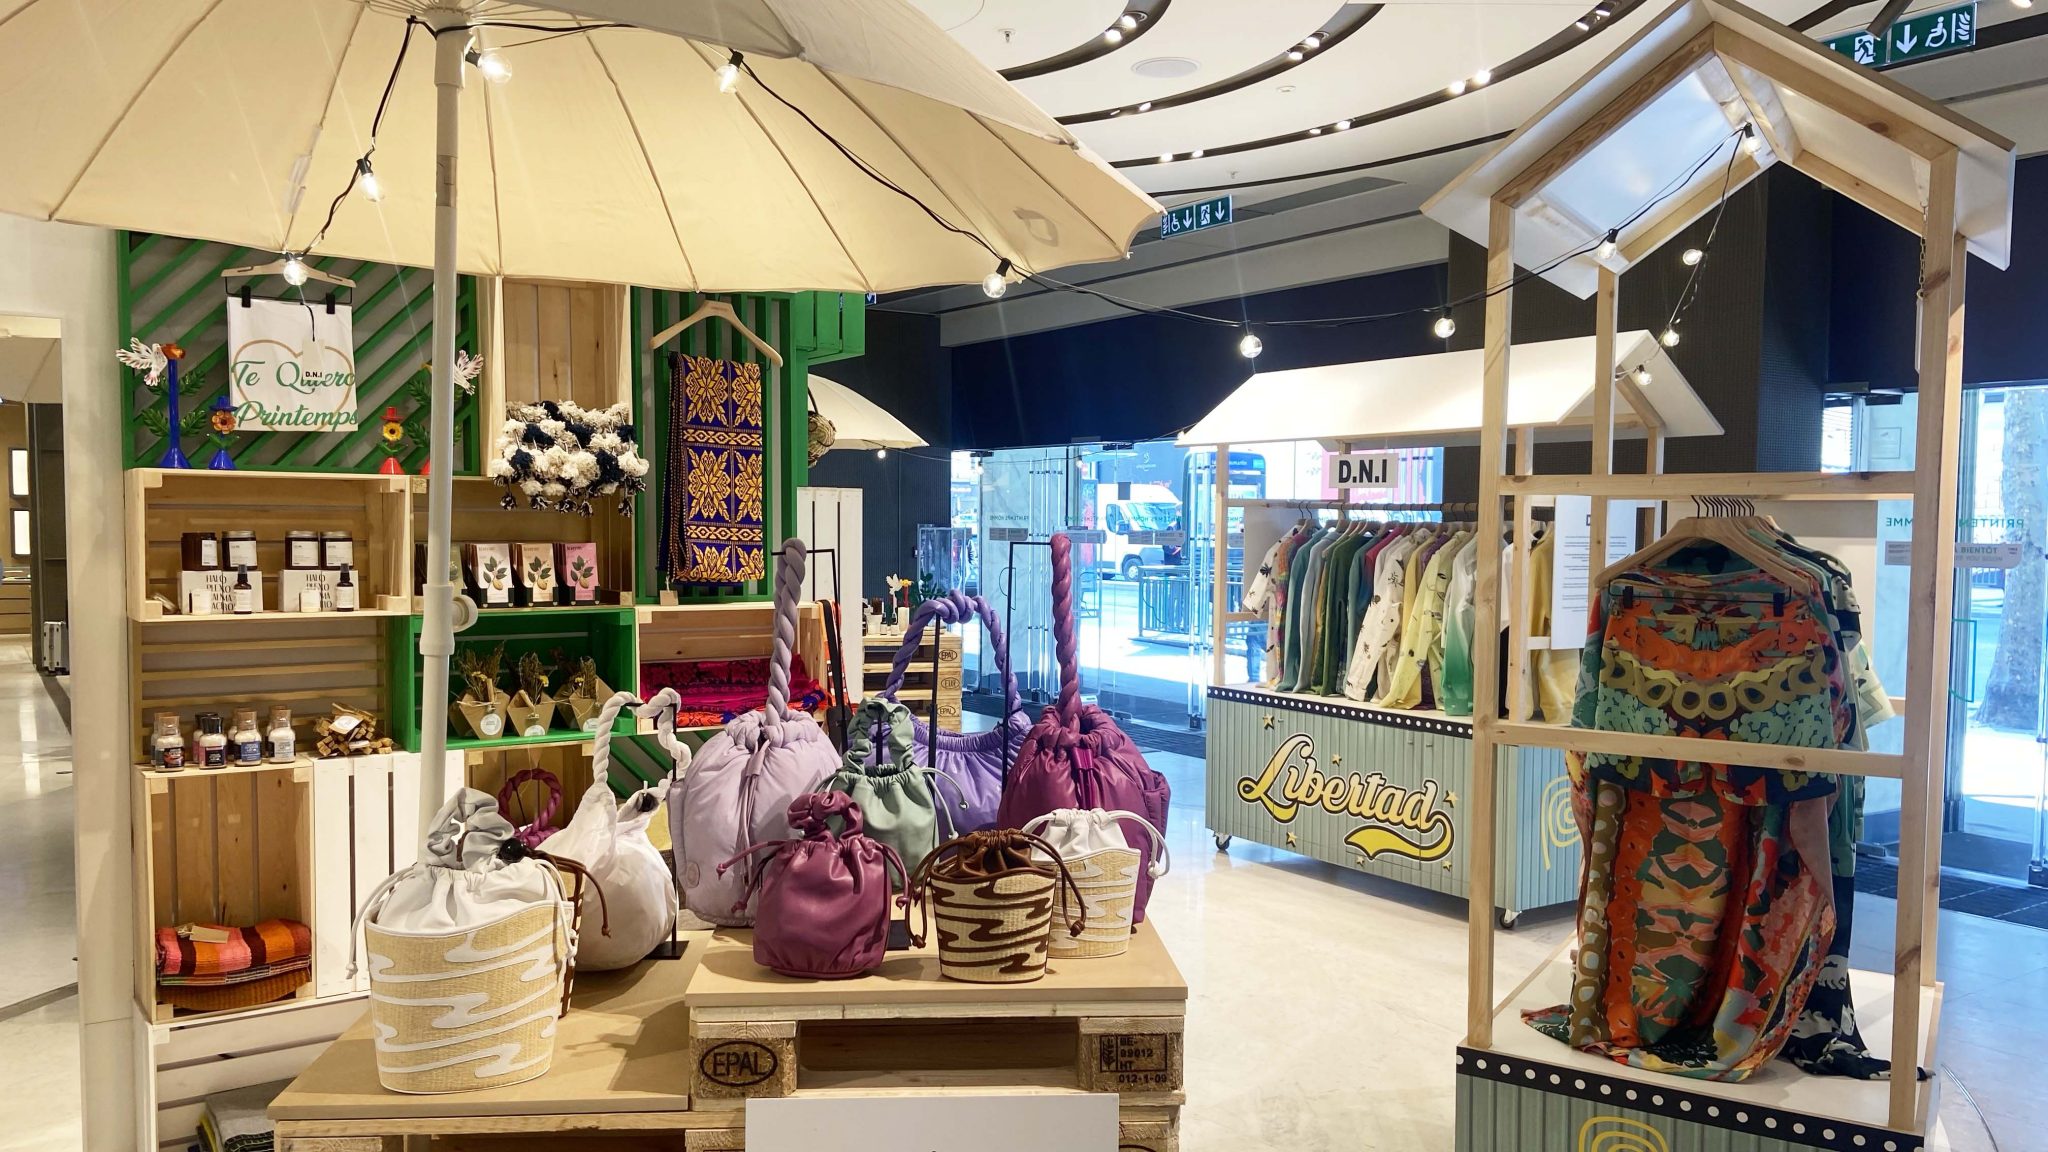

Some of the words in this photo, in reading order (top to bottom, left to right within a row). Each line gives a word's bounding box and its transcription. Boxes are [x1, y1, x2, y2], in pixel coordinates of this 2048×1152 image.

[230, 360, 265, 387] Te
[234, 400, 359, 432] Printemps
[1338, 459, 1387, 483] D.N.I
[1237, 732, 1454, 857] Libertad
[712, 1049, 766, 1077] EPAL
[1119, 1061, 1133, 1070] HT
